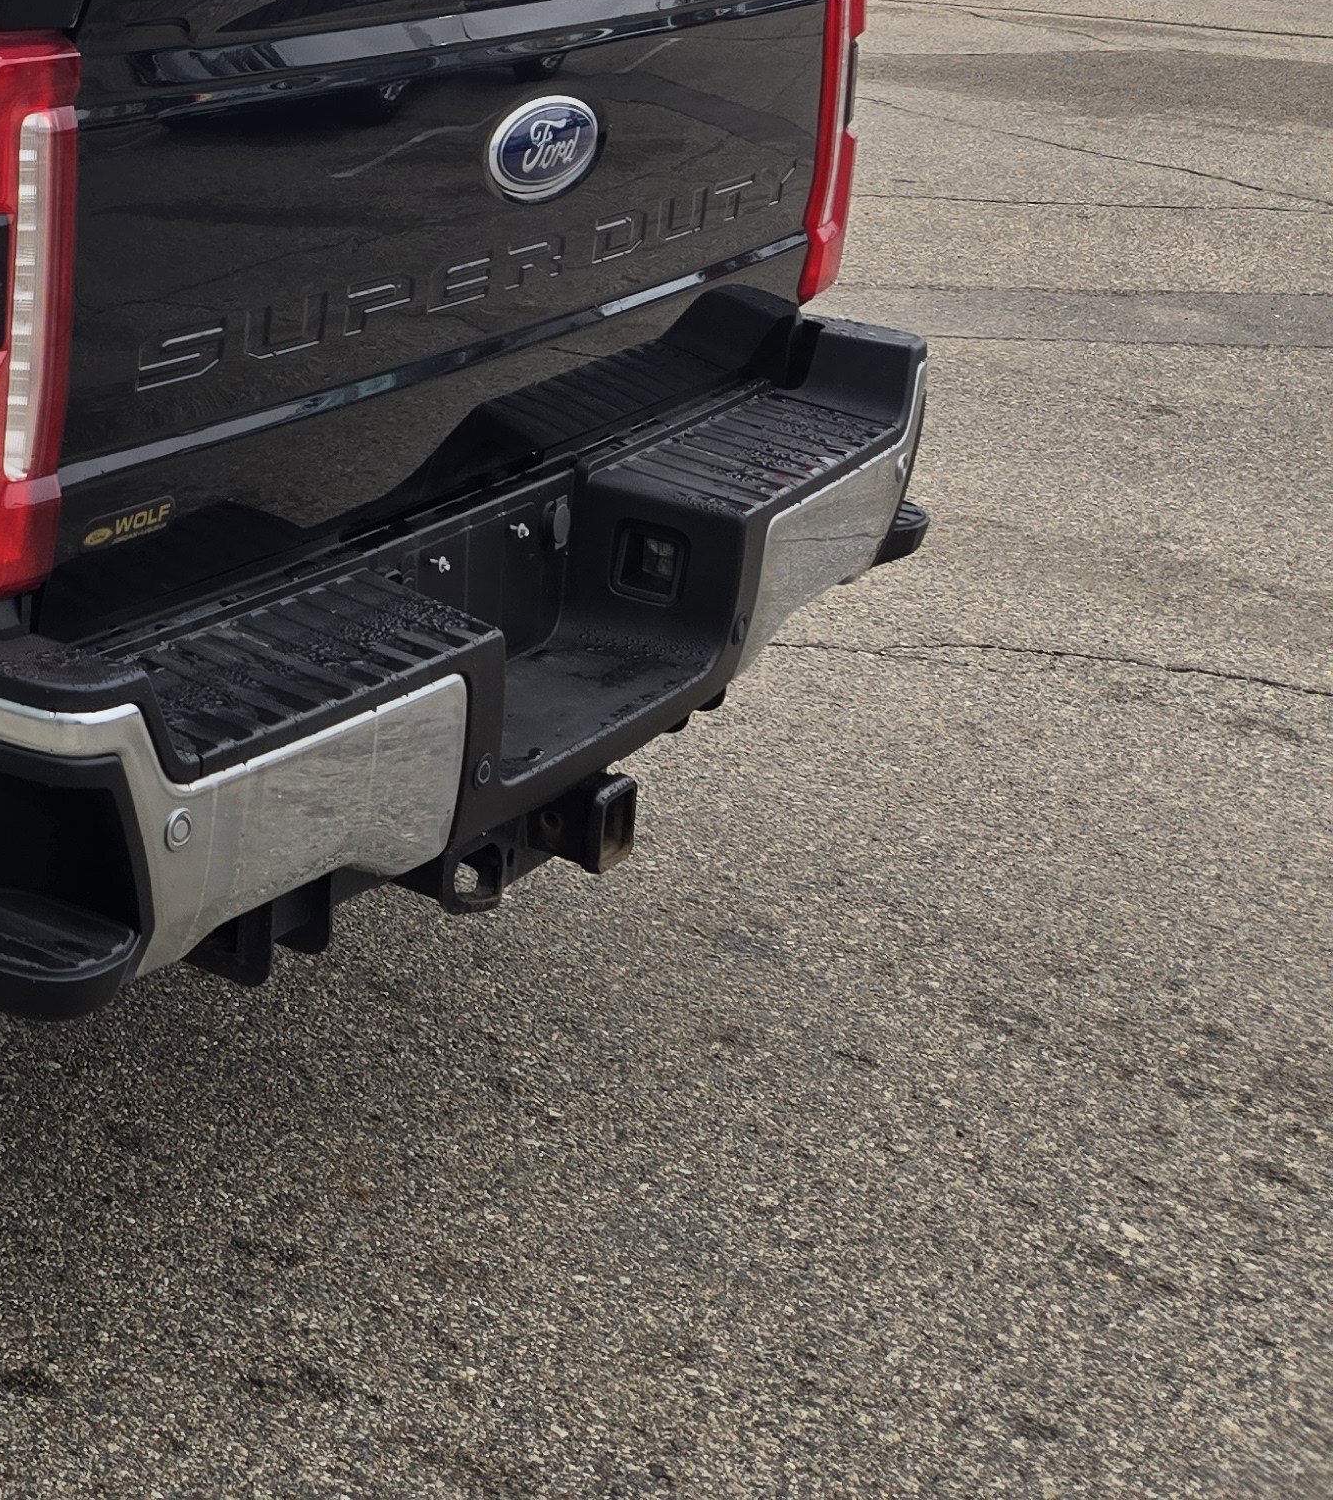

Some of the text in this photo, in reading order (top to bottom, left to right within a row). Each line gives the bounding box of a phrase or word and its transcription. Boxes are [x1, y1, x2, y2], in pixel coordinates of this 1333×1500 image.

[522, 118, 581, 173] Ford
[135, 160, 799, 393] SUPER DUTY
[115, 503, 171, 535] WOLF
